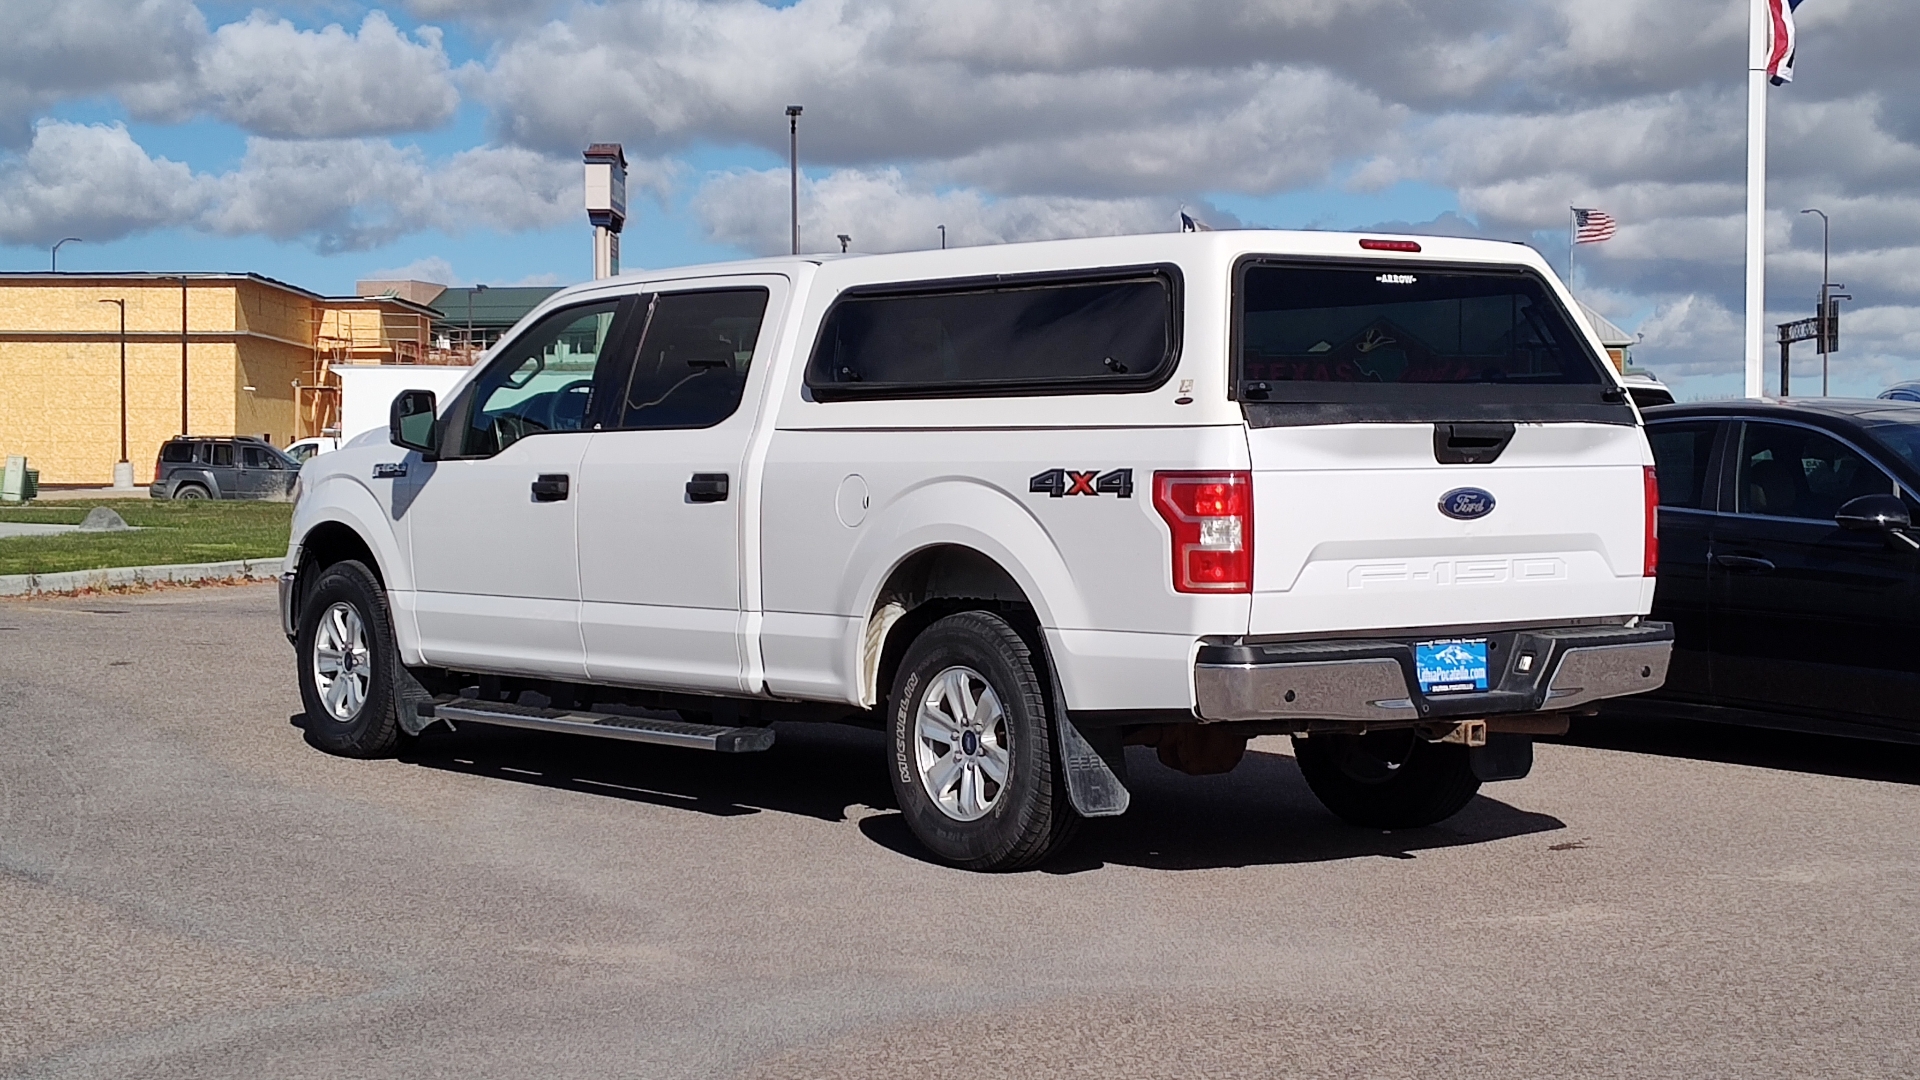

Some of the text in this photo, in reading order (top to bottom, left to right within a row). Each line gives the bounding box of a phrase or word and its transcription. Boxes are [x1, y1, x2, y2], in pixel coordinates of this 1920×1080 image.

[1381, 274, 1413, 284] ARROW
[1029, 468, 1133, 498] 4X4
[1453, 494, 1486, 512] Ford
[1347, 557, 1567, 589] F-150
[896, 672, 920, 783] MICHELIN
